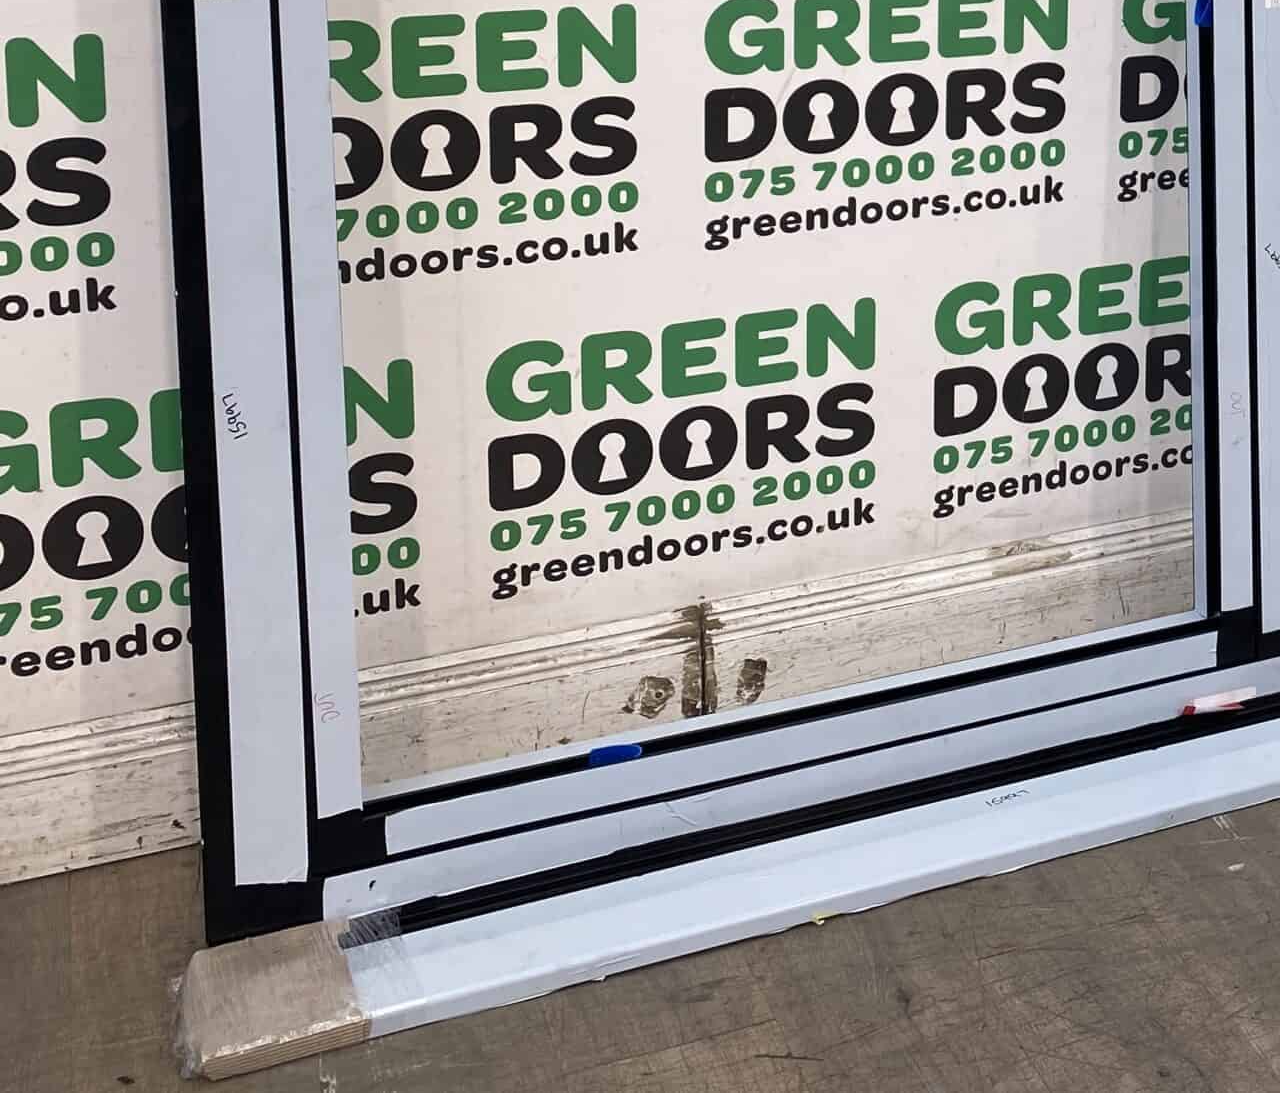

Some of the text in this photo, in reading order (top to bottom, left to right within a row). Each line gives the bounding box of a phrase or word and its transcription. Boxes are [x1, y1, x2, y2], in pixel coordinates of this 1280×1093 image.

[704, 61, 1066, 163] DOORS
[500, 182, 638, 224] 2000
[705, 139, 1065, 202] 075 7000 2000
[705, 175, 1063, 250] greendoors.co.uk
[486, 298, 875, 422] GREEN
[487, 383, 875, 512] DOORS
[934, 415, 1135, 473] 075 7000
[490, 460, 874, 551] 075 7000 2000
[491, 497, 873, 600] greendoors.co.uk
